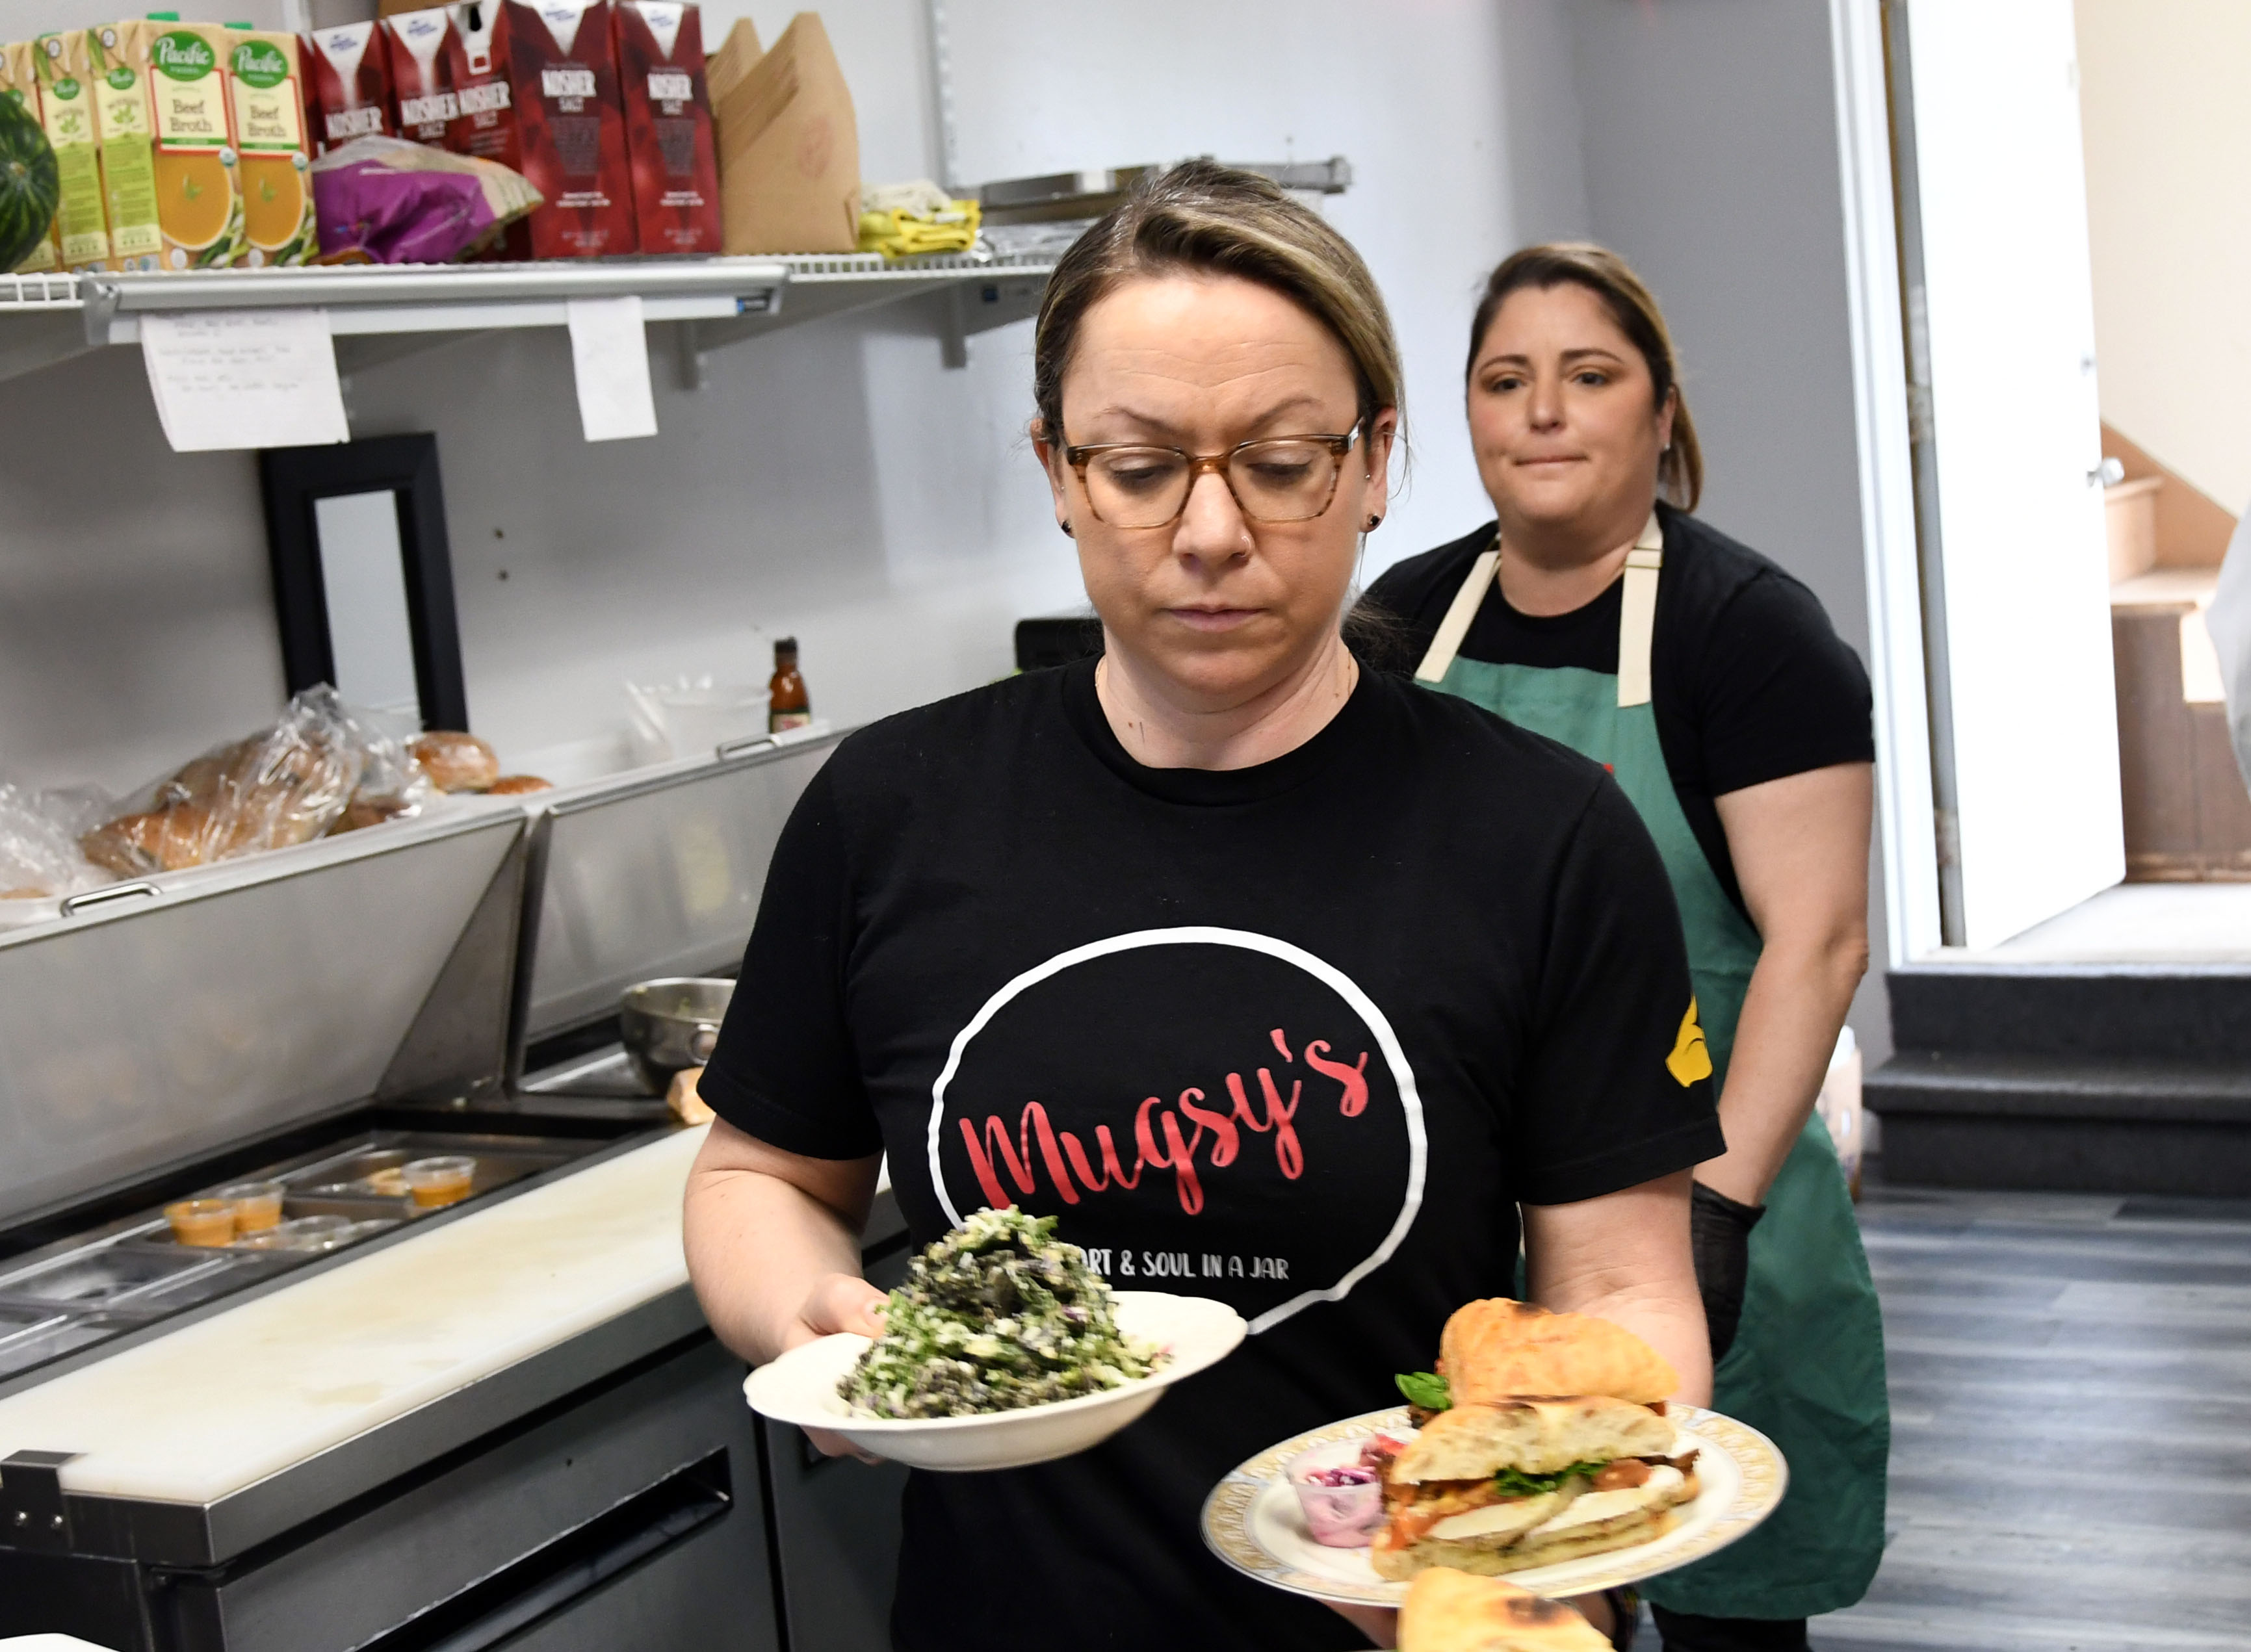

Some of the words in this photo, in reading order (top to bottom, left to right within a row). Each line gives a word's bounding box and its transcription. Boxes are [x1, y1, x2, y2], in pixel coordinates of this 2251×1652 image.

[155, 36, 210, 66] Pacific
[233, 44, 283, 73] Pacific
[172, 98, 205, 114] Beef
[249, 104, 280, 120] Beef
[169, 116, 213, 132] Broth
[246, 121, 287, 137] Broth
[959, 1027, 1369, 1215] Mugsy's
[1120, 1249, 1136, 1276] &
[1141, 1251, 1197, 1278] SOUL
[1202, 1253, 1222, 1278] IN
[1228, 1255, 1244, 1278] A
[1249, 1256, 1290, 1280] JAR
